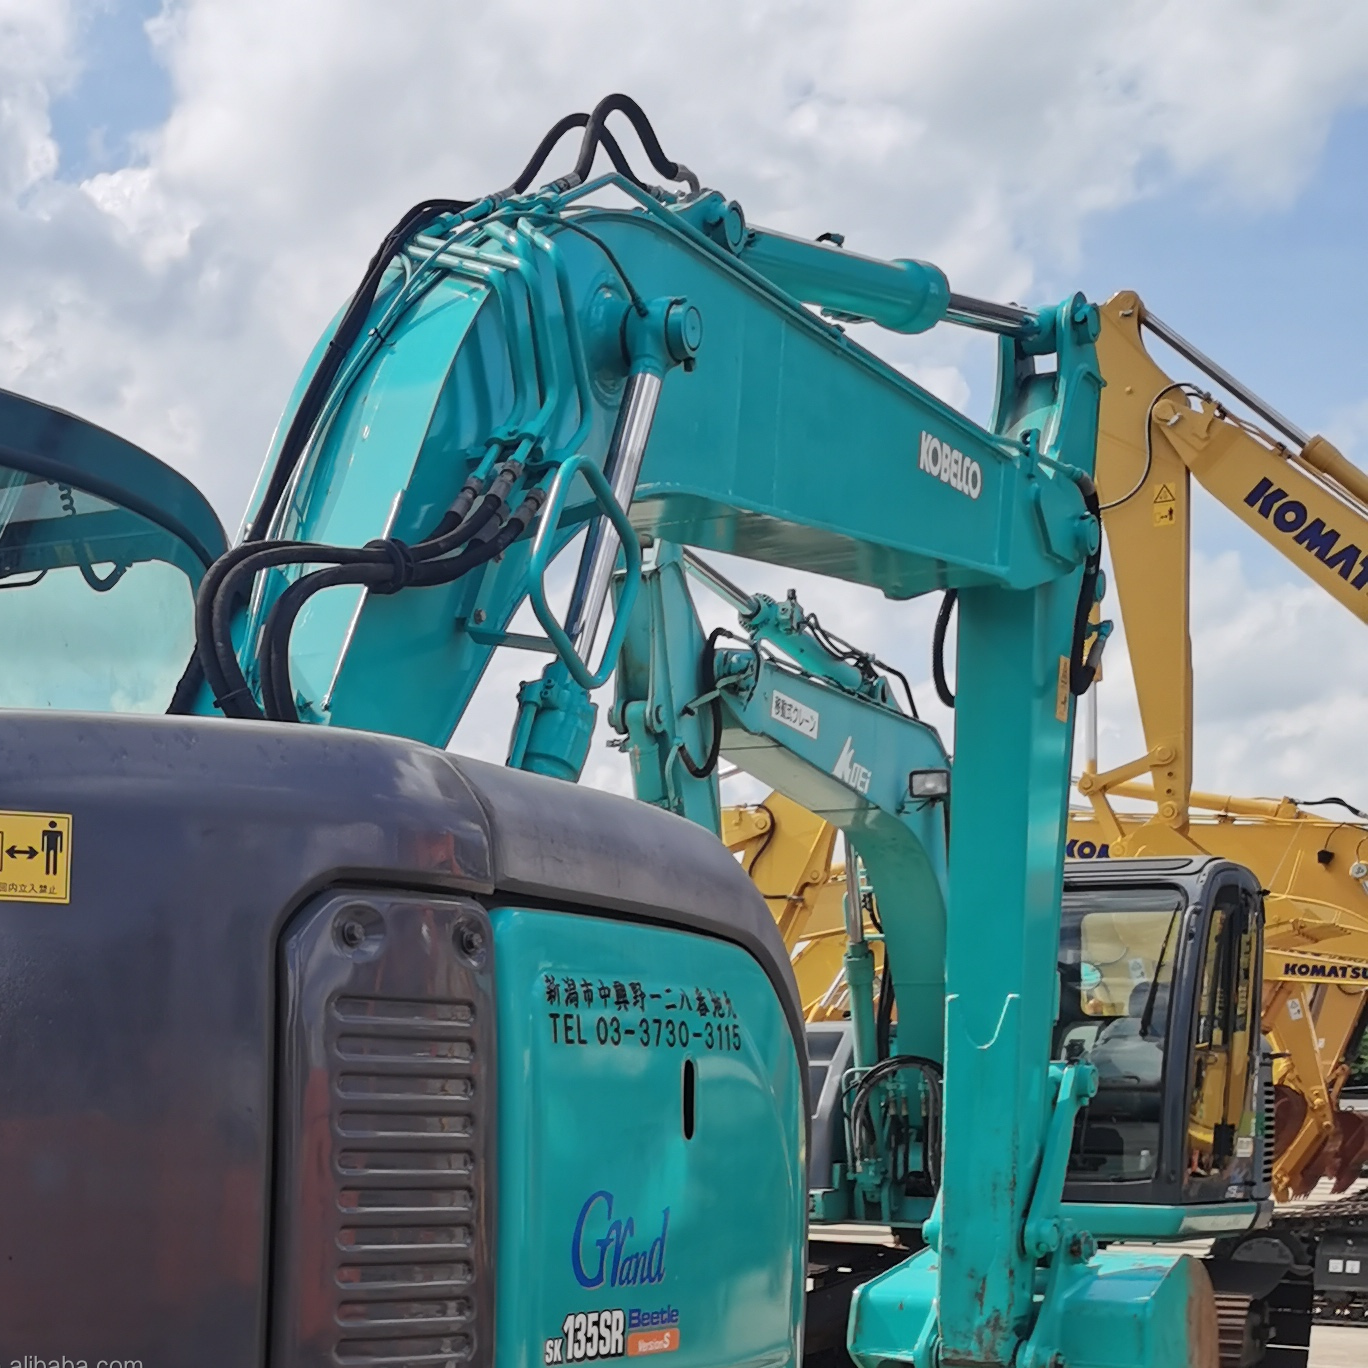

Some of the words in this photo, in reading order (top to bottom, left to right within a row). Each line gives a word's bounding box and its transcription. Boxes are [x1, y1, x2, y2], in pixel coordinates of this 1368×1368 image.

[918, 429, 983, 500] KOBELCO
[549, 1012, 588, 1045] TEL
[596, 1016, 742, 1051] 03-3730-3115
[571, 1190, 670, 1290] Grand
[628, 1304, 679, 1329] Beetle
